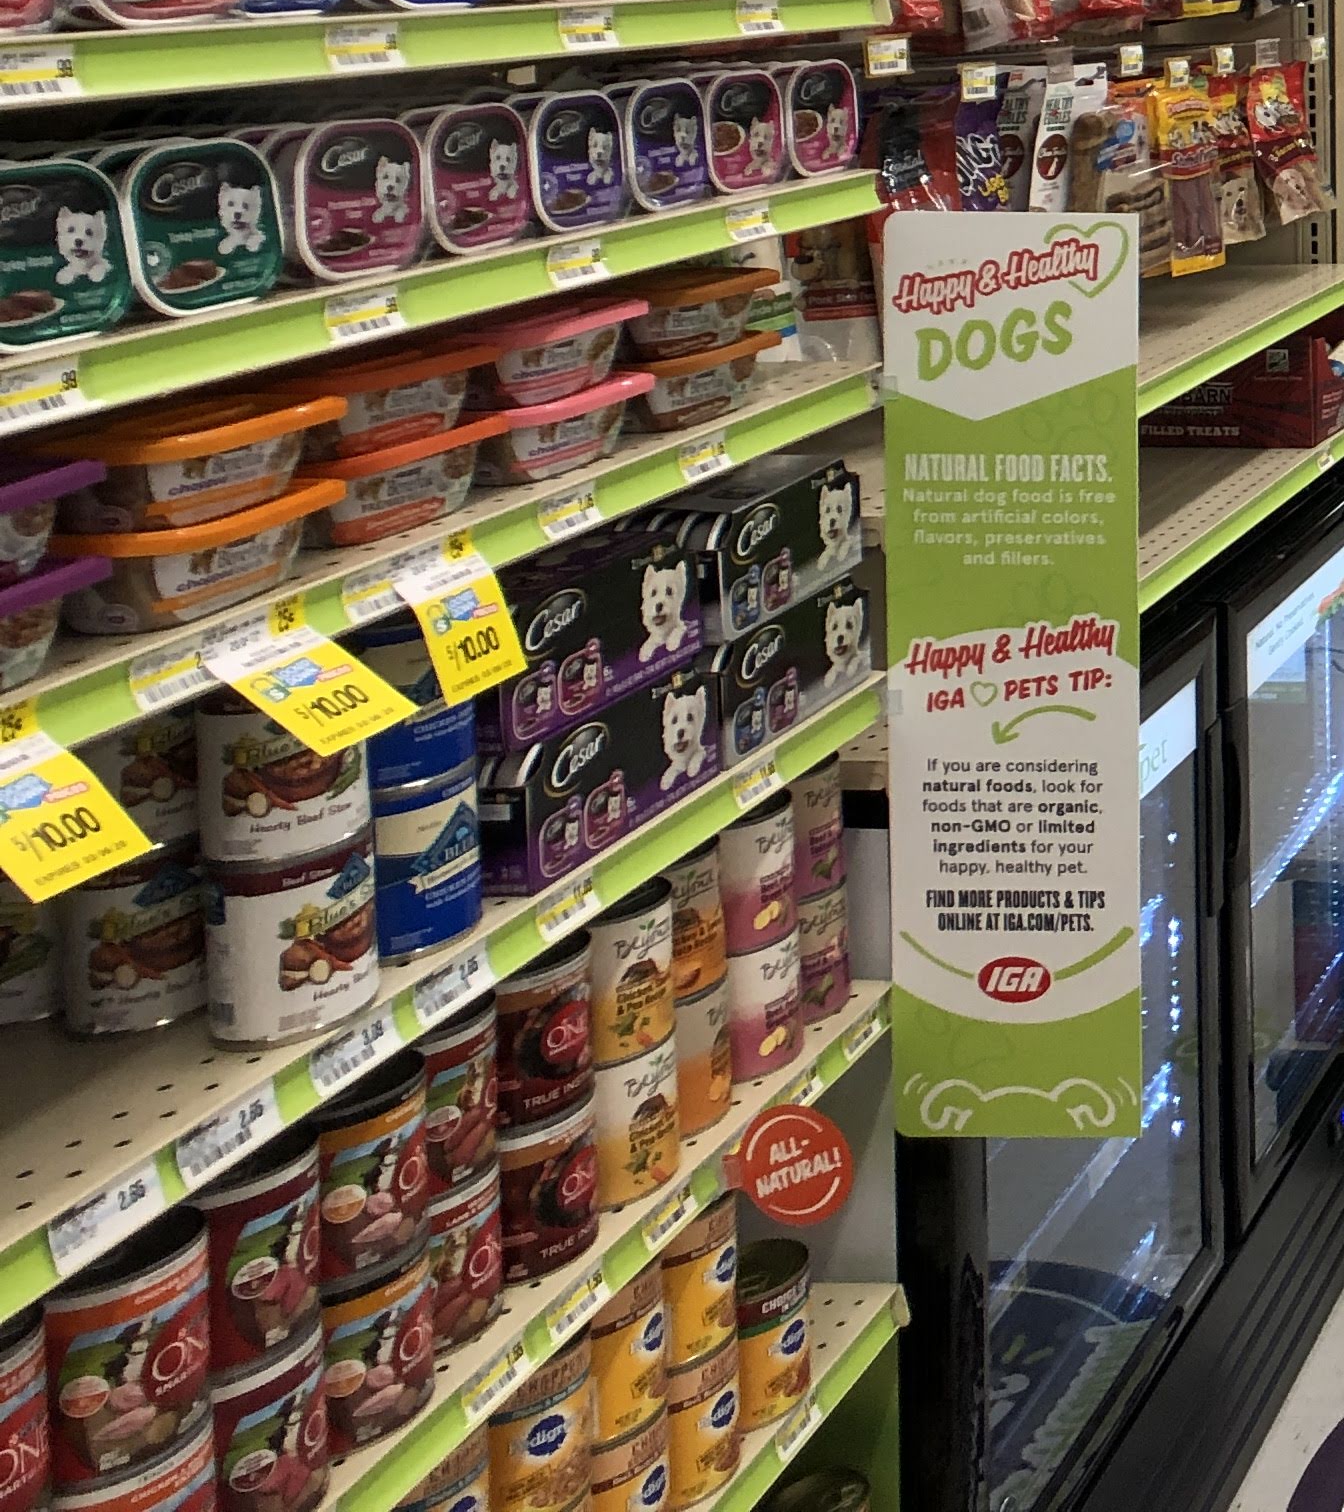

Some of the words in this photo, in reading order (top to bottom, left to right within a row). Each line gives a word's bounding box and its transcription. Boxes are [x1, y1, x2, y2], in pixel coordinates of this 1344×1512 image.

[893, 273, 975, 314] Happy
[976, 260, 1001, 296] &
[1004, 239, 1100, 287] Healthy
[916, 300, 1073, 381] DOGS
[1186, 426, 1239, 436] TREATS
[905, 454, 988, 482] NATURAL
[996, 454, 1043, 482] FOOD
[1050, 454, 1112, 482] FACTS.
[903, 488, 968, 503] Natural
[974, 489, 1006, 505] dog
[1012, 489, 1052, 504] food
[1059, 489, 1073, 504] is
[1079, 489, 1116, 504] free
[913, 510, 956, 524] from
[962, 510, 1036, 524] artificial
[1042, 510, 1104, 526] colors,
[737, 511, 777, 556] Cesar
[914, 530, 978, 546] flavors,
[985, 531, 1106, 547] preservatives
[963, 551, 994, 566] and
[1001, 551, 1055, 566] fillers.
[525, 598, 582, 652] Cesar
[905, 642, 985, 679] Happy
[991, 634, 1011, 663] &
[1019, 619, 1115, 660] Healthy
[927, 689, 965, 712] IGA
[1004, 675, 1058, 701] PETS
[1069, 668, 1112, 693] TIP:
[927, 759, 938, 774] If
[942, 762, 970, 776] you
[974, 763, 1001, 773] are
[1004, 759, 1099, 777] considering
[922, 779, 981, 793] natural
[986, 779, 1037, 795] foods,
[1041, 779, 1075, 793] look
[1080, 779, 1103, 793] for
[922, 799, 967, 813] foods
[971, 799, 1003, 813] that
[1007, 802, 1033, 813] are
[1037, 800, 1103, 817] organic,
[930, 820, 1011, 834] non-GMO
[1015, 823, 1033, 834] or
[1037, 819, 1096, 834] limited
[932, 838, 1027, 857] ingredients
[1030, 839, 1053, 854] for
[1057, 842, 1094, 857] your
[939, 860, 991, 877] happy,
[995, 860, 1052, 877] healthy
[1057, 862, 1088, 877] pet.
[926, 891, 955, 909] FIND
[957, 891, 994, 909] MORE
[996, 891, 1062, 909] PRODUCTS
[1063, 892, 1075, 909] &
[1077, 891, 1106, 910] TIPS
[937, 913, 983, 932] ONLINE
[985, 913, 1001, 932] AT
[1003, 913, 1095, 934] IGA.COM/PETS.
[986, 966, 1044, 992] IGA
[769, 1137, 810, 1165] ALL-
[755, 1146, 842, 1198] NATURAL!
